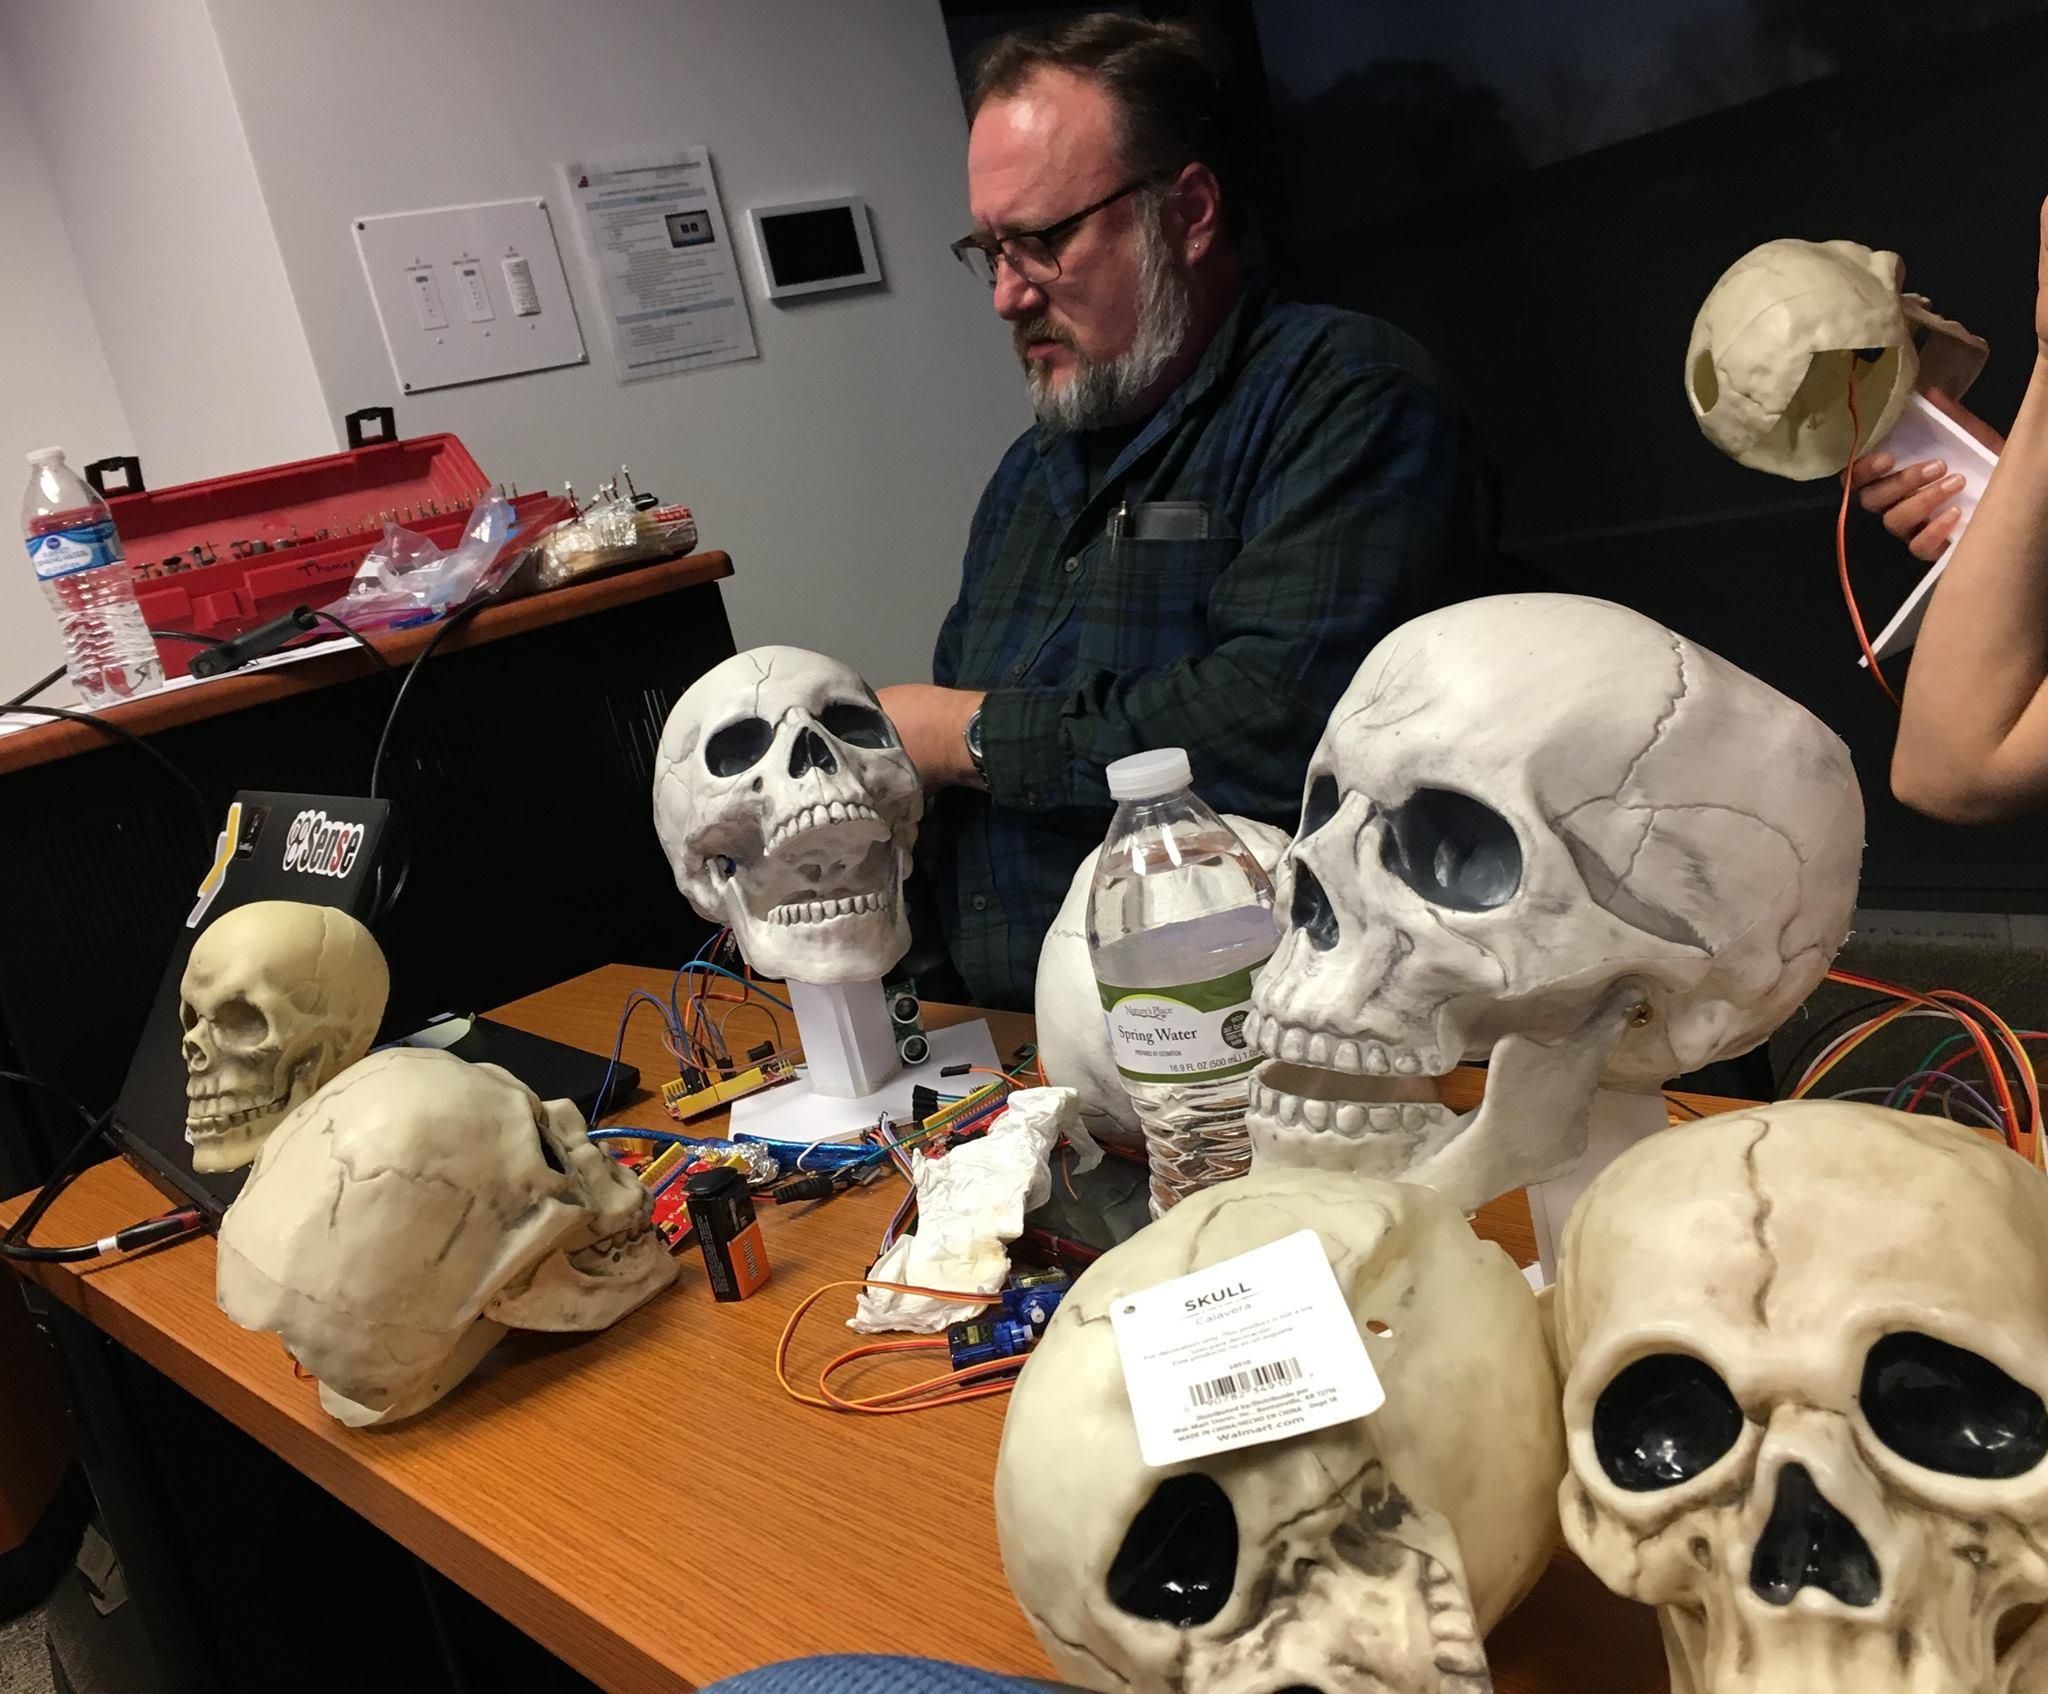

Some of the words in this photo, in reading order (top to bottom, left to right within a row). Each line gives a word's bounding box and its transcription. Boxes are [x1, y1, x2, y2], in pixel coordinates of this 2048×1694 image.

[1152, 1006, 1173, 1016] Place
[1118, 1025, 1155, 1046] Spring
[1154, 1028, 1198, 1042] Water
[1169, 1064, 1186, 1073] 16.9
[1186, 1063, 1196, 1071] FL
[1197, 1061, 1208, 1070] OZ
[1209, 1058, 1226, 1070] (500
[1185, 1283, 1251, 1311] SKULL
[1193, 1304, 1251, 1325] Calavera
[1217, 1417, 1304, 1441] Walmart.com
